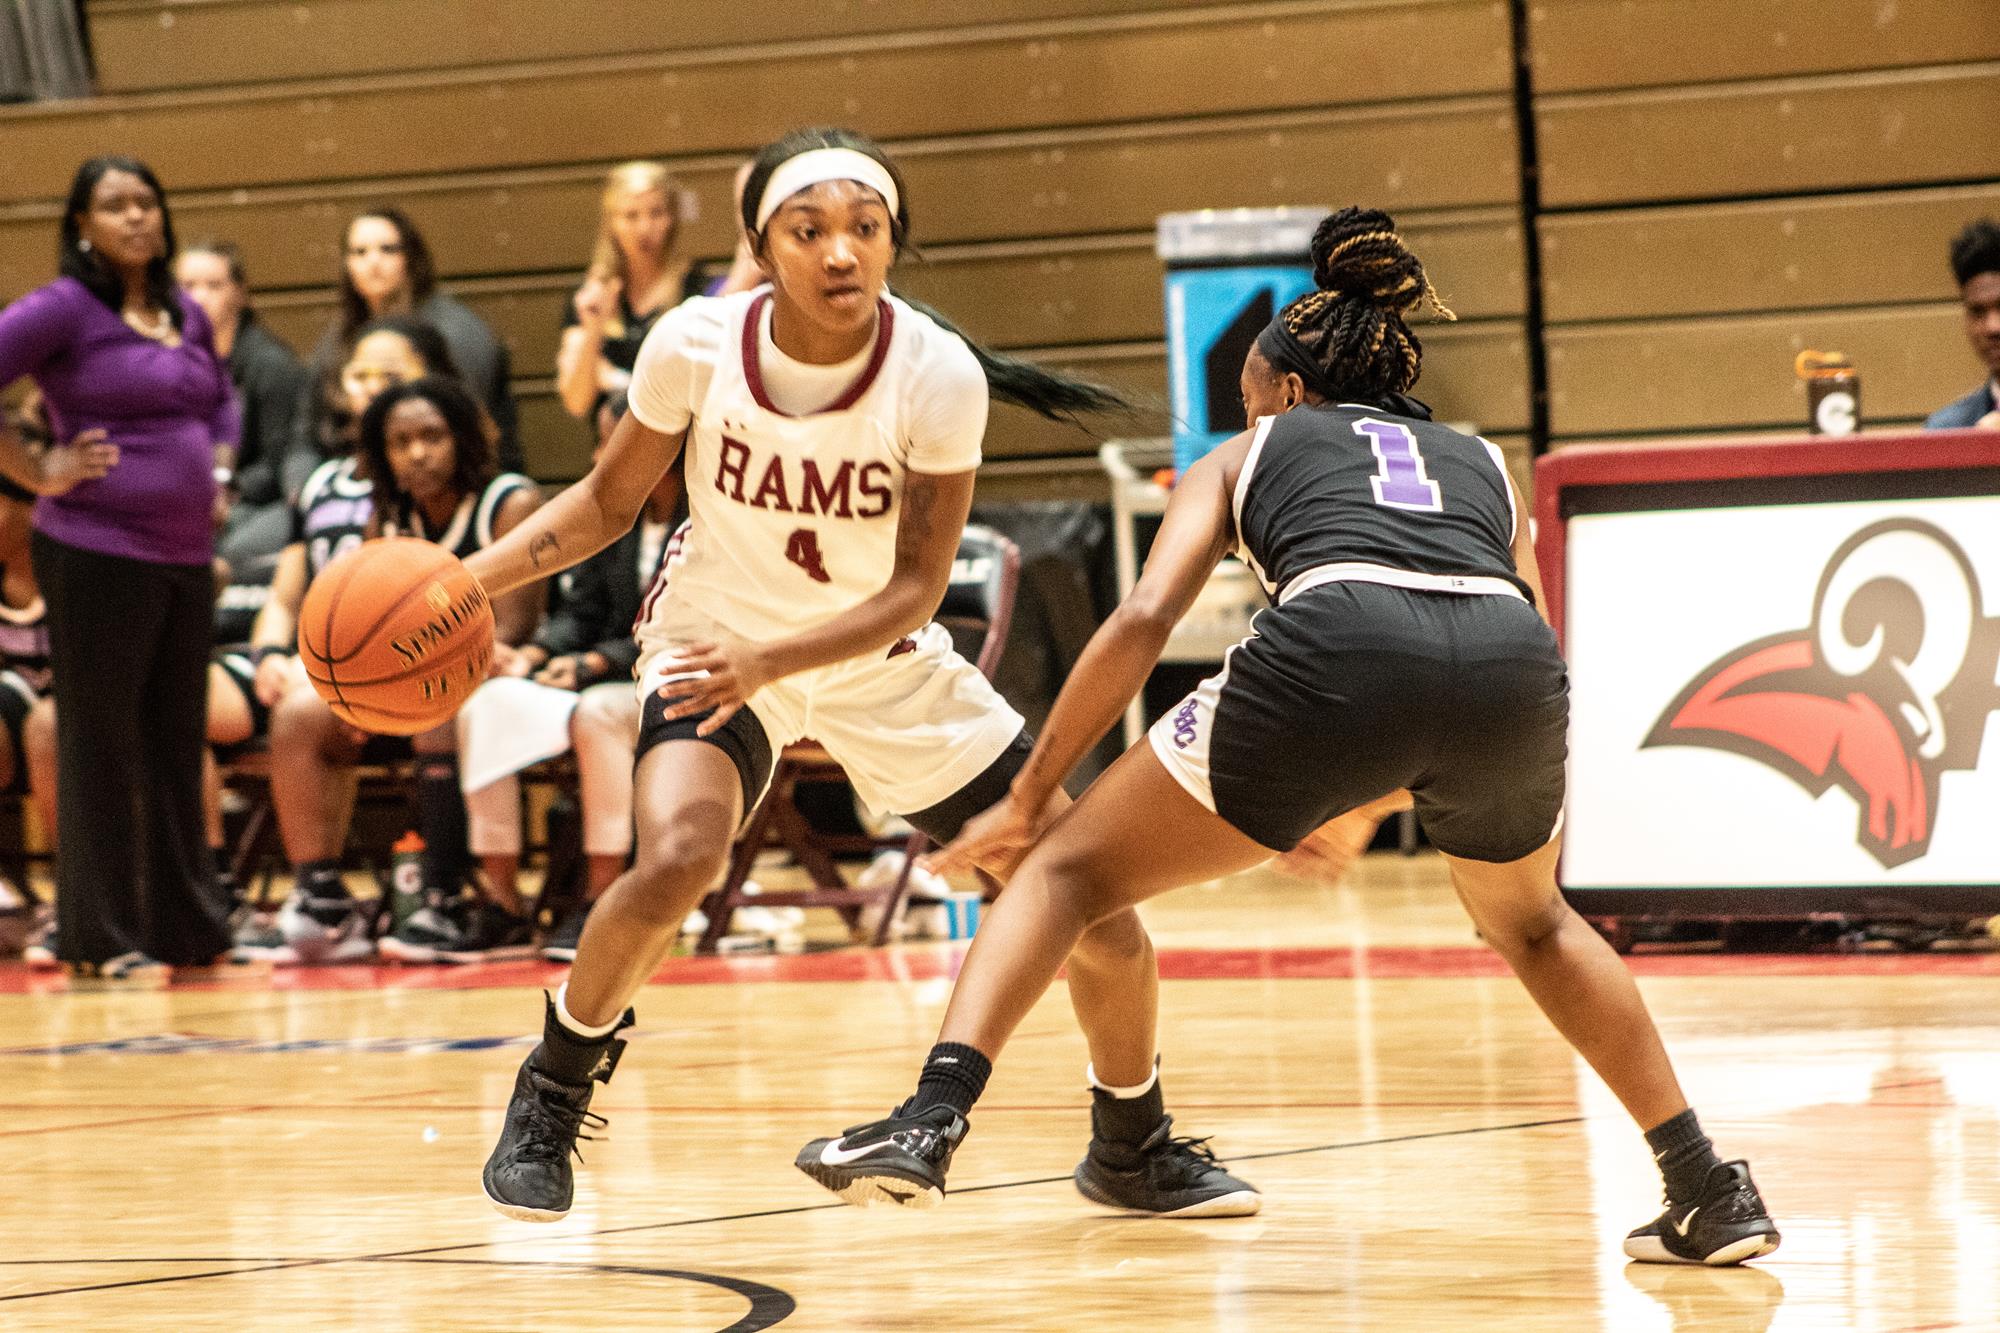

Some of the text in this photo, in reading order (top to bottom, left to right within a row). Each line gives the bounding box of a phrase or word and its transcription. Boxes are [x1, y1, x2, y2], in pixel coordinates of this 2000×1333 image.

[715, 434, 892, 519] RAMS
[1351, 416, 1443, 512] 1
[784, 528, 831, 583] 4
